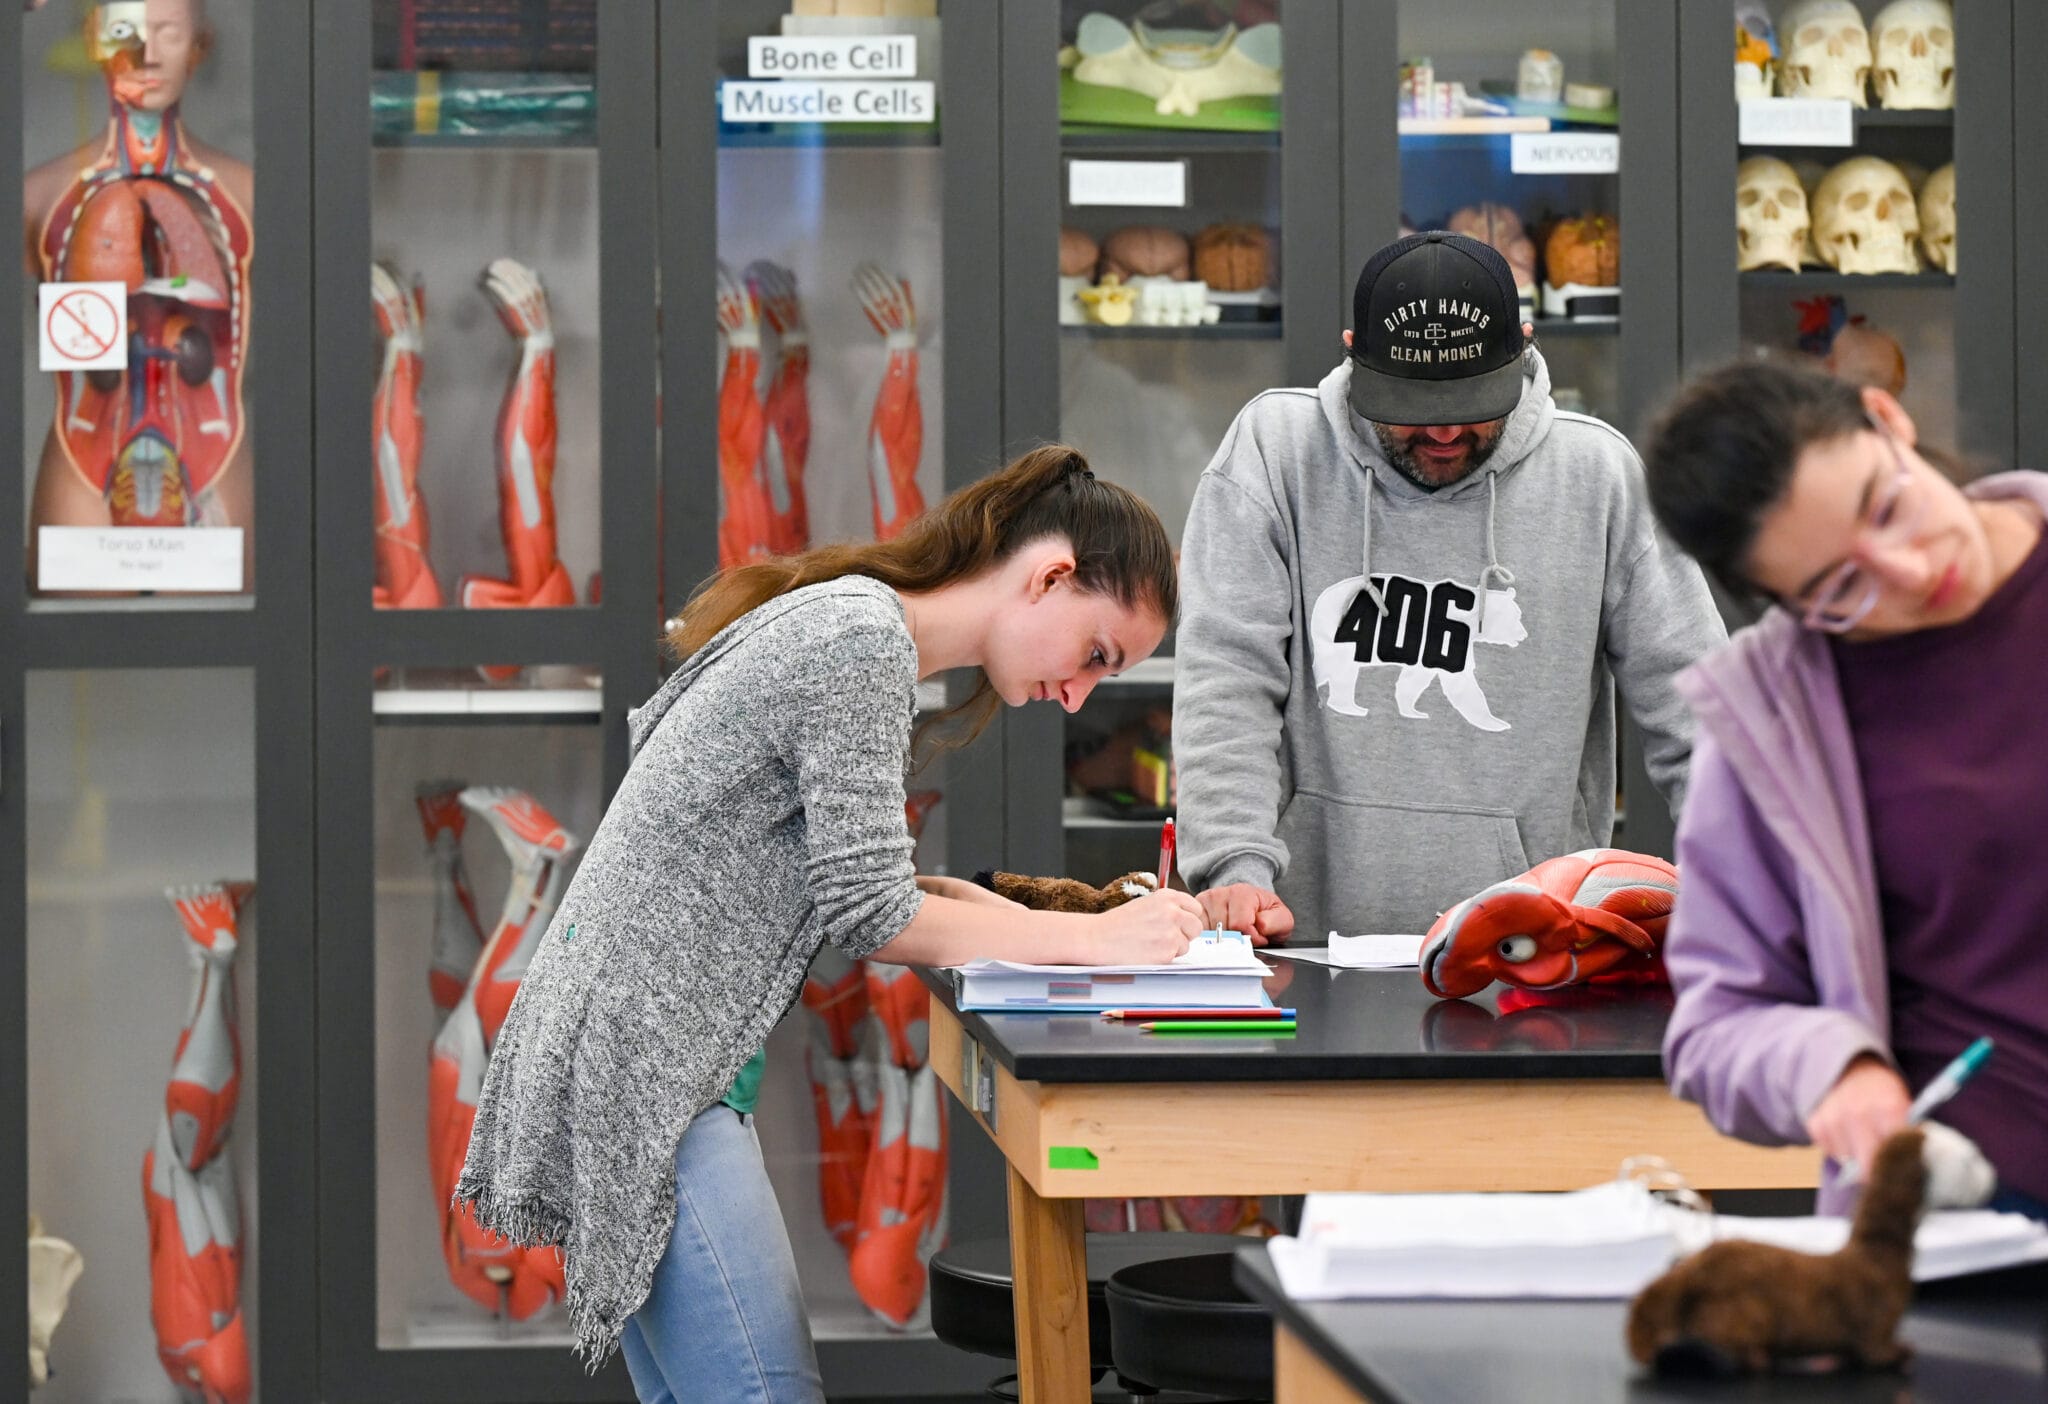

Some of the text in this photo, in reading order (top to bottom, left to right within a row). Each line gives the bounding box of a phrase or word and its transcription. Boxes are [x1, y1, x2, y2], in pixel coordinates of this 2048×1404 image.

[761, 44, 902, 70] Bone Cell
[735, 89, 923, 114] Muscle Cells
[1384, 298, 1490, 332] DIRTY HANDS
[1391, 342, 1483, 363] CLEAN MONEY
[1333, 575, 1476, 673] 406
